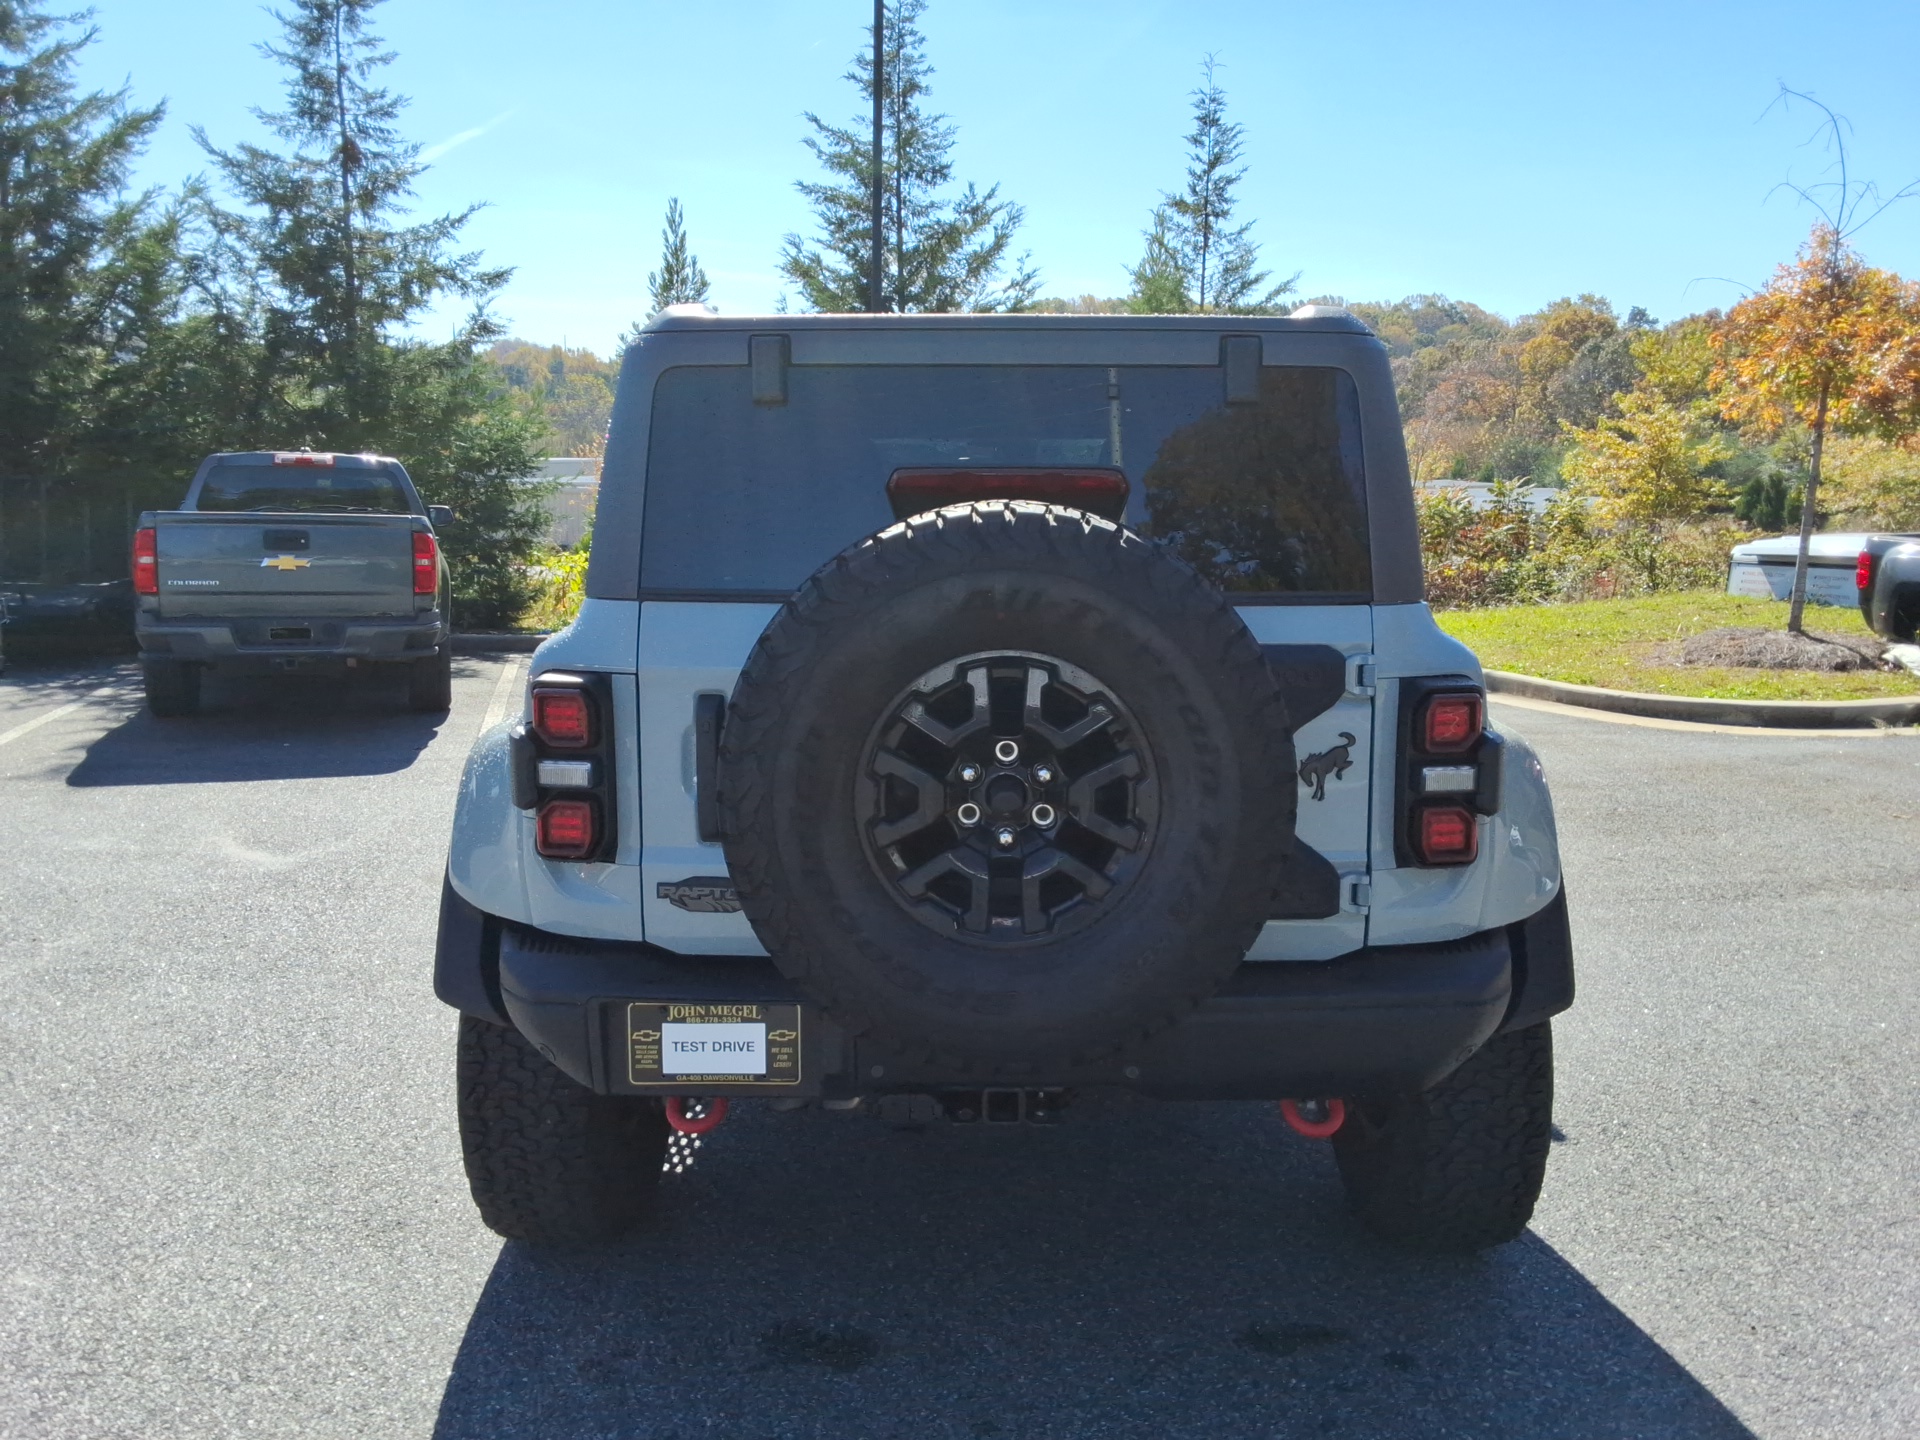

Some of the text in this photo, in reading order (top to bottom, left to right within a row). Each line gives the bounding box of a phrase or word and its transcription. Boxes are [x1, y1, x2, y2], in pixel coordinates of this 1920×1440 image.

[667, 1005, 761, 1022] JOHN MEGEL
[672, 1041, 707, 1052] TEST
[713, 1041, 755, 1052] DRIVE
